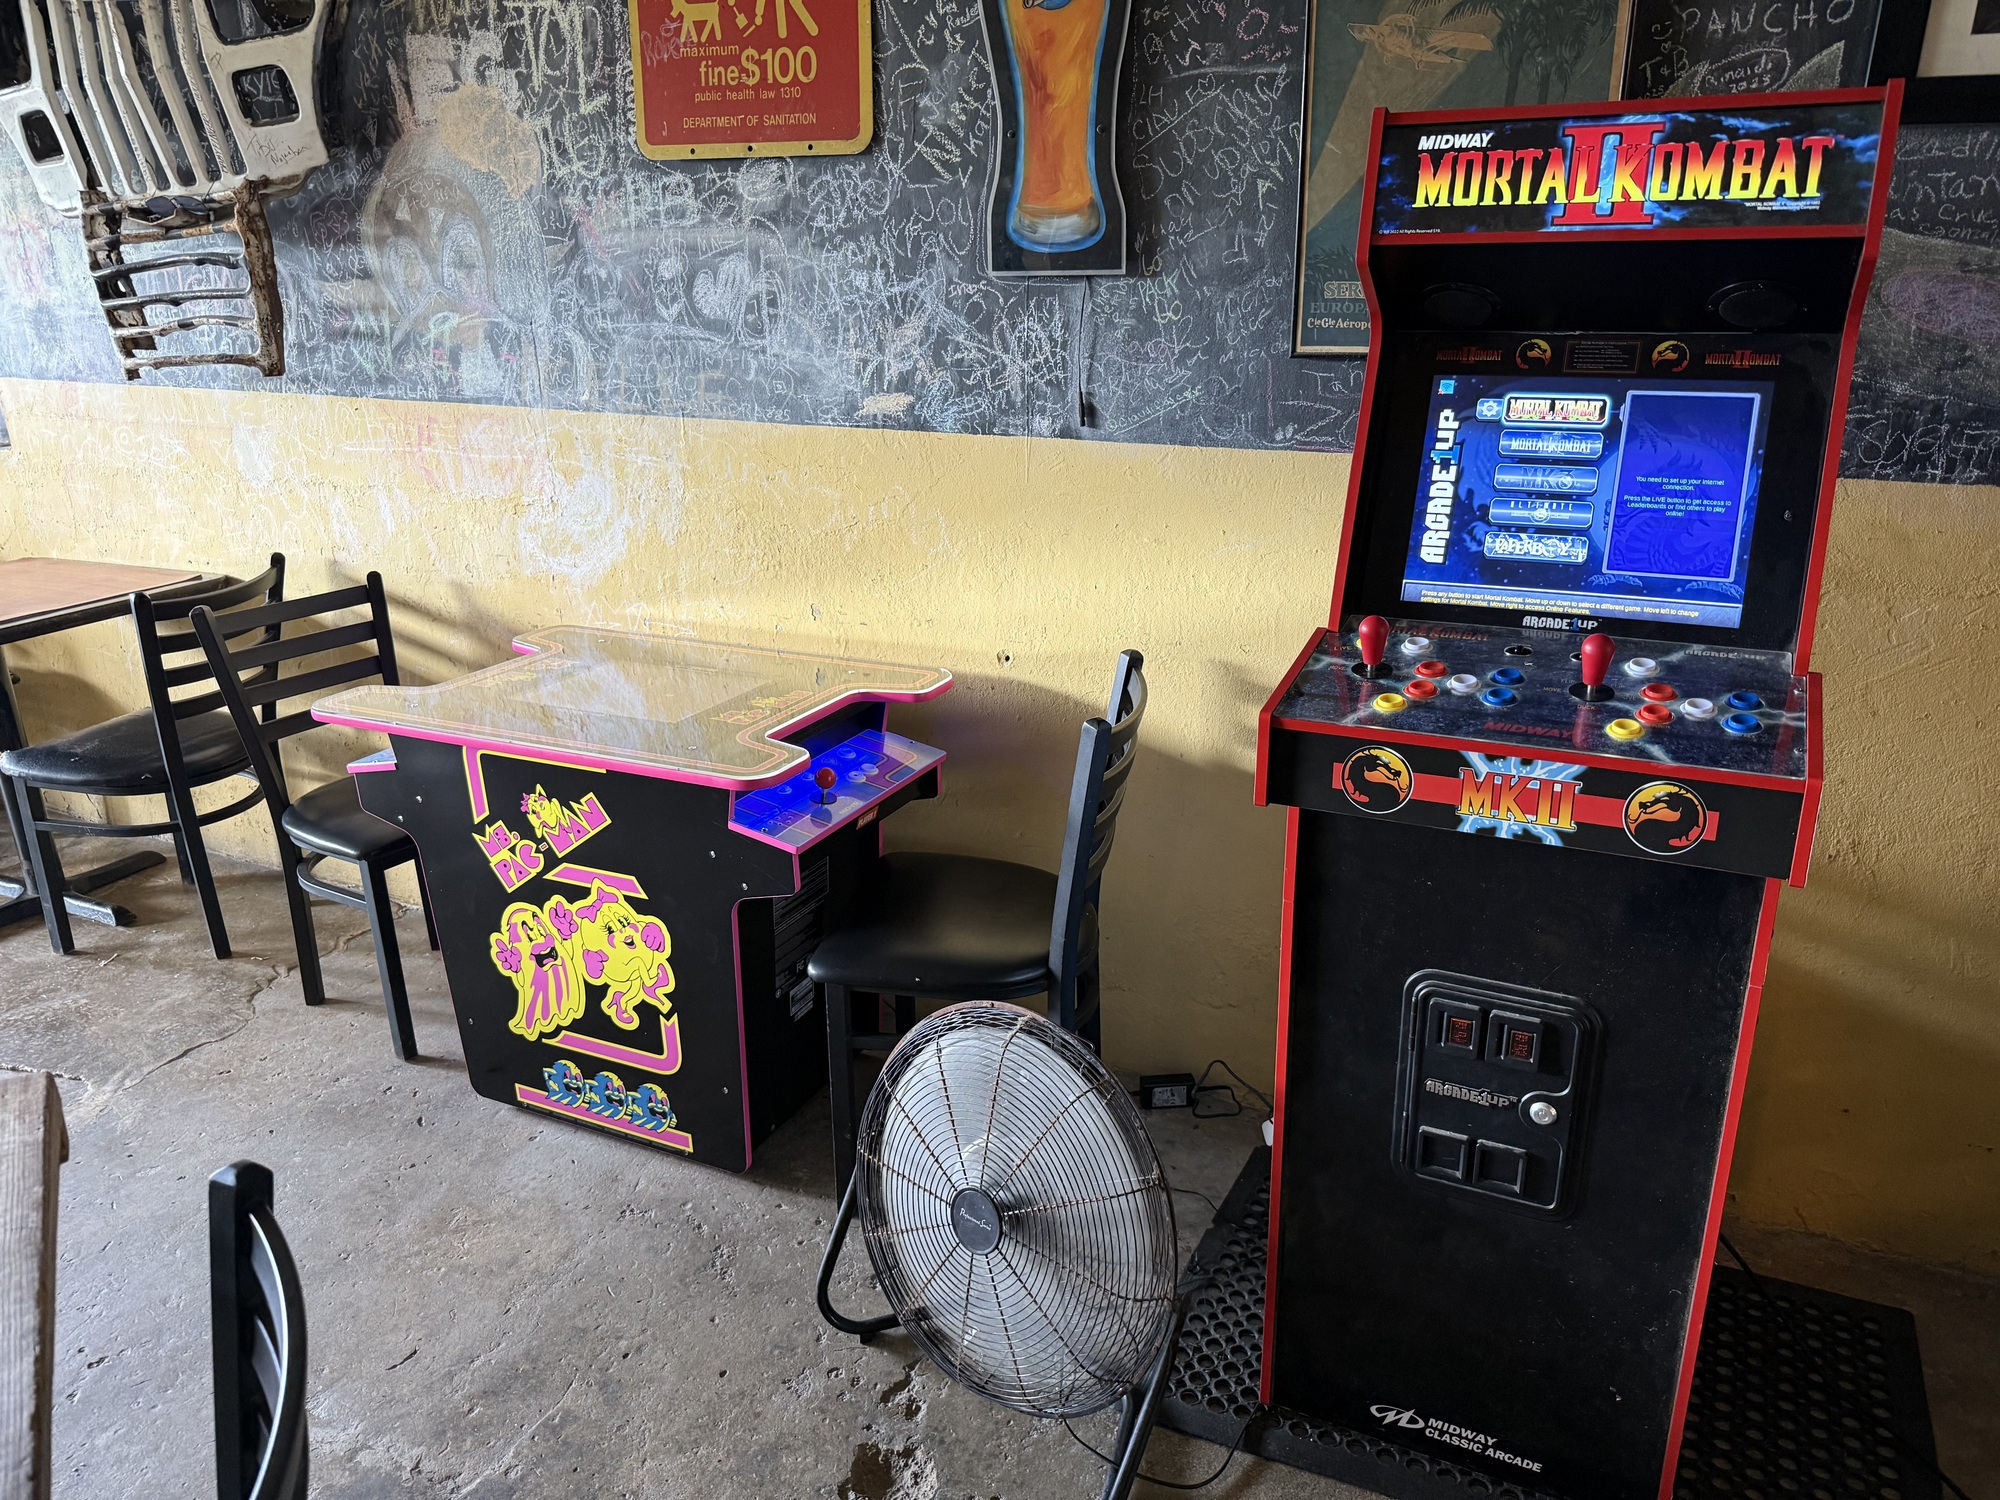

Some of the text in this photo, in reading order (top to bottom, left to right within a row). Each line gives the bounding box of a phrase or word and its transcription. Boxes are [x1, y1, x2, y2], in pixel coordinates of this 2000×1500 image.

[680, 45, 739, 58] maximum
[699, 45, 817, 87] fine $100
[694, 86, 801, 103] public health law 1310
[683, 113, 817, 129] DEPARTMENT OF SANITATION
[1418, 132, 1494, 150] MIDWAY
[1411, 148, 1600, 208] MORTAL
[1607, 136, 1836, 203] KOMBAT
[1324, 281, 1366, 299] SER
[1704, 351, 1743, 366] MORTAL
[1743, 352, 1782, 367] KOMBAT
[1508, 398, 1604, 421] MORTAL KOMBAT
[1510, 436, 1592, 454] MORTAL KOMBAT
[1420, 409, 1461, 564] ARCADE1UP
[1495, 536, 1571, 557] PAPERBOY
[1420, 596, 1441, 604] settings
[1545, 605, 1564, 613] Online
[1564, 606, 1591, 615] Features.
[1421, 590, 1437, 598] Press
[1448, 591, 1464, 599] button
[1556, 599, 1571, 607] down
[1601, 603, 1624, 611] different
[1643, 606, 1660, 614] Move
[1677, 609, 1699, 617] change
[1522, 615, 1598, 631] ARCADE1UP
[1482, 721, 1575, 738] MIDWAY
[1455, 766, 1584, 832] MKII
[489, 791, 613, 894] PAC-MAN
[1424, 1077, 1511, 1107] ARCADE1UP
[1427, 1417, 1498, 1446] MIDWAY
[1425, 1427, 1543, 1473] CLASSIC ARCADE
